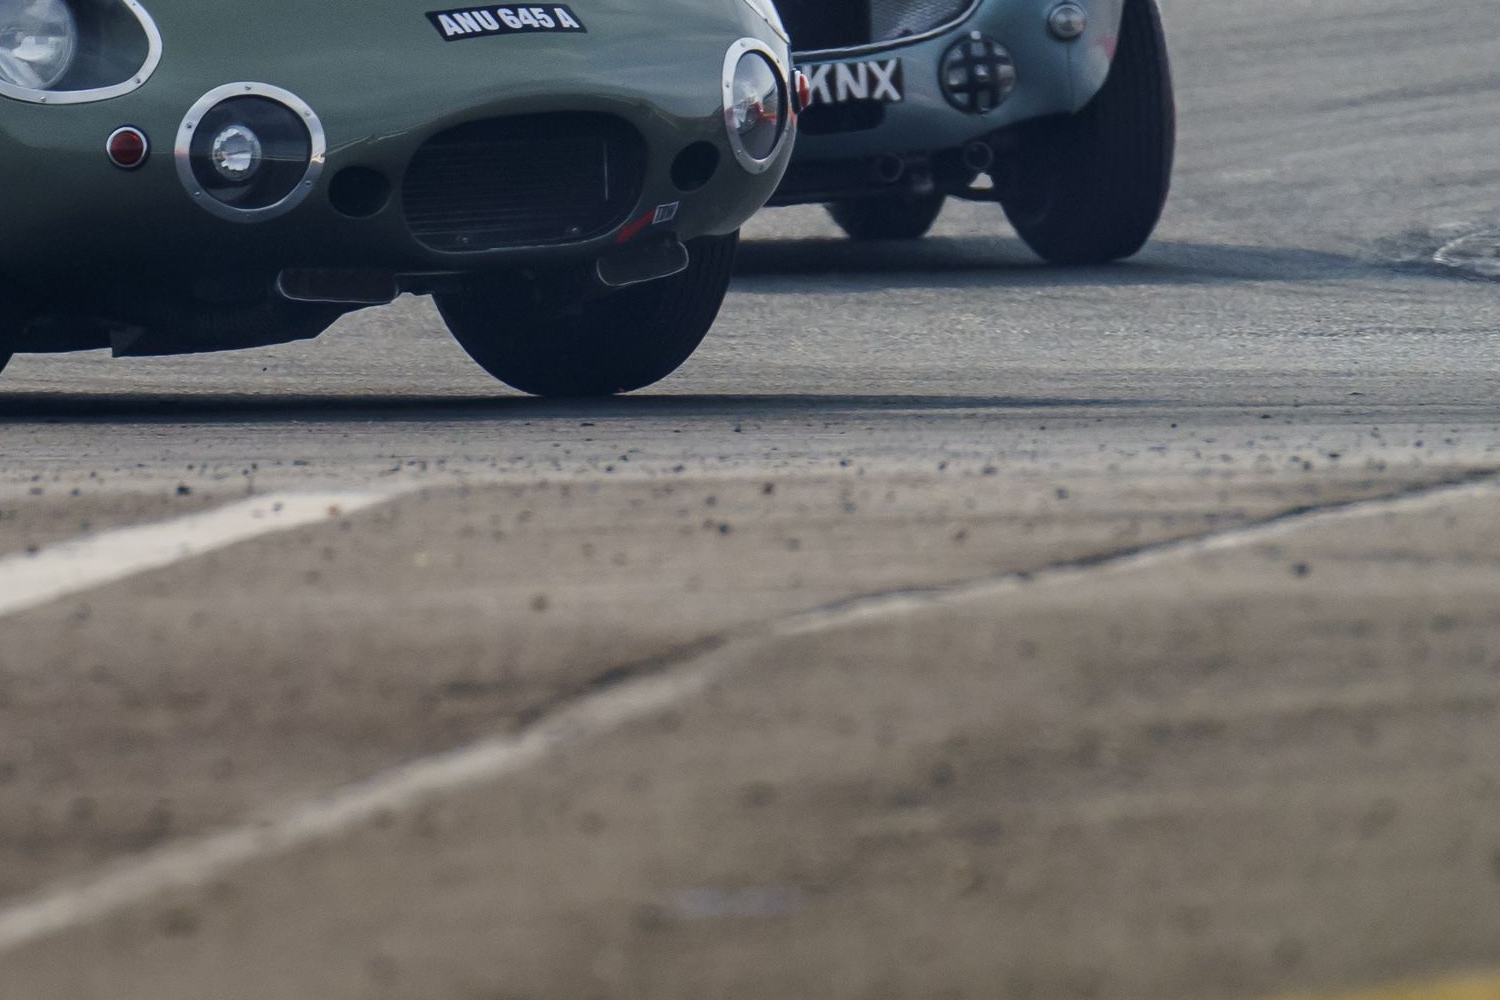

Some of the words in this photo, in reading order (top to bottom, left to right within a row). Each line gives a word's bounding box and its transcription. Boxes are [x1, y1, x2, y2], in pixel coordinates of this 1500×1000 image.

[437, 10, 500, 36] ANU
[497, 7, 556, 29] 645
[553, 7, 581, 29] A
[800, 59, 901, 104] KNX
